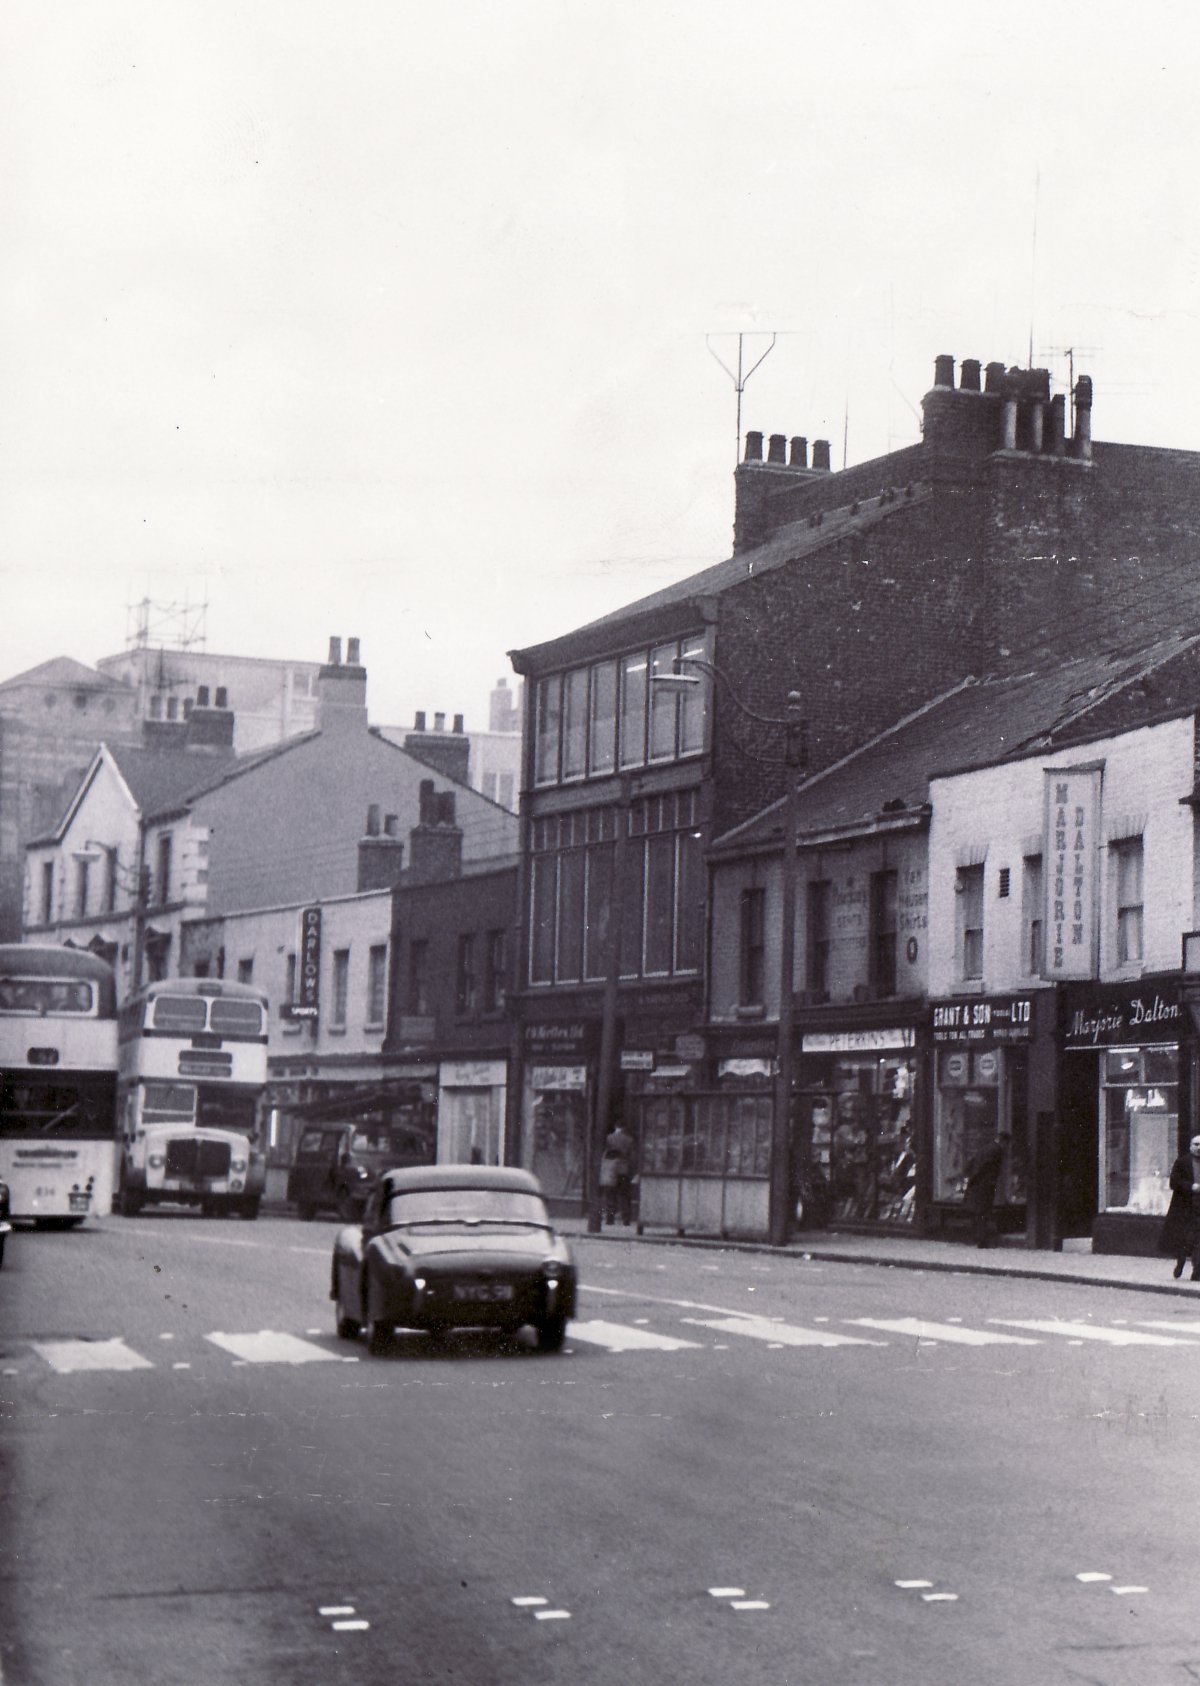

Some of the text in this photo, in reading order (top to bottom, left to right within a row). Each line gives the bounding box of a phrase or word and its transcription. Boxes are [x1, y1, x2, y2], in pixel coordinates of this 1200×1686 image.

[1054, 783, 1068, 968] MARJORIE
[1072, 806, 1085, 945] DALTON
[934, 1006, 961, 1027] GRANT
[973, 1004, 991, 1025] SON
[1011, 1001, 1030, 1022] LTD
[1066, 1005, 1123, 1044] Marjorie
